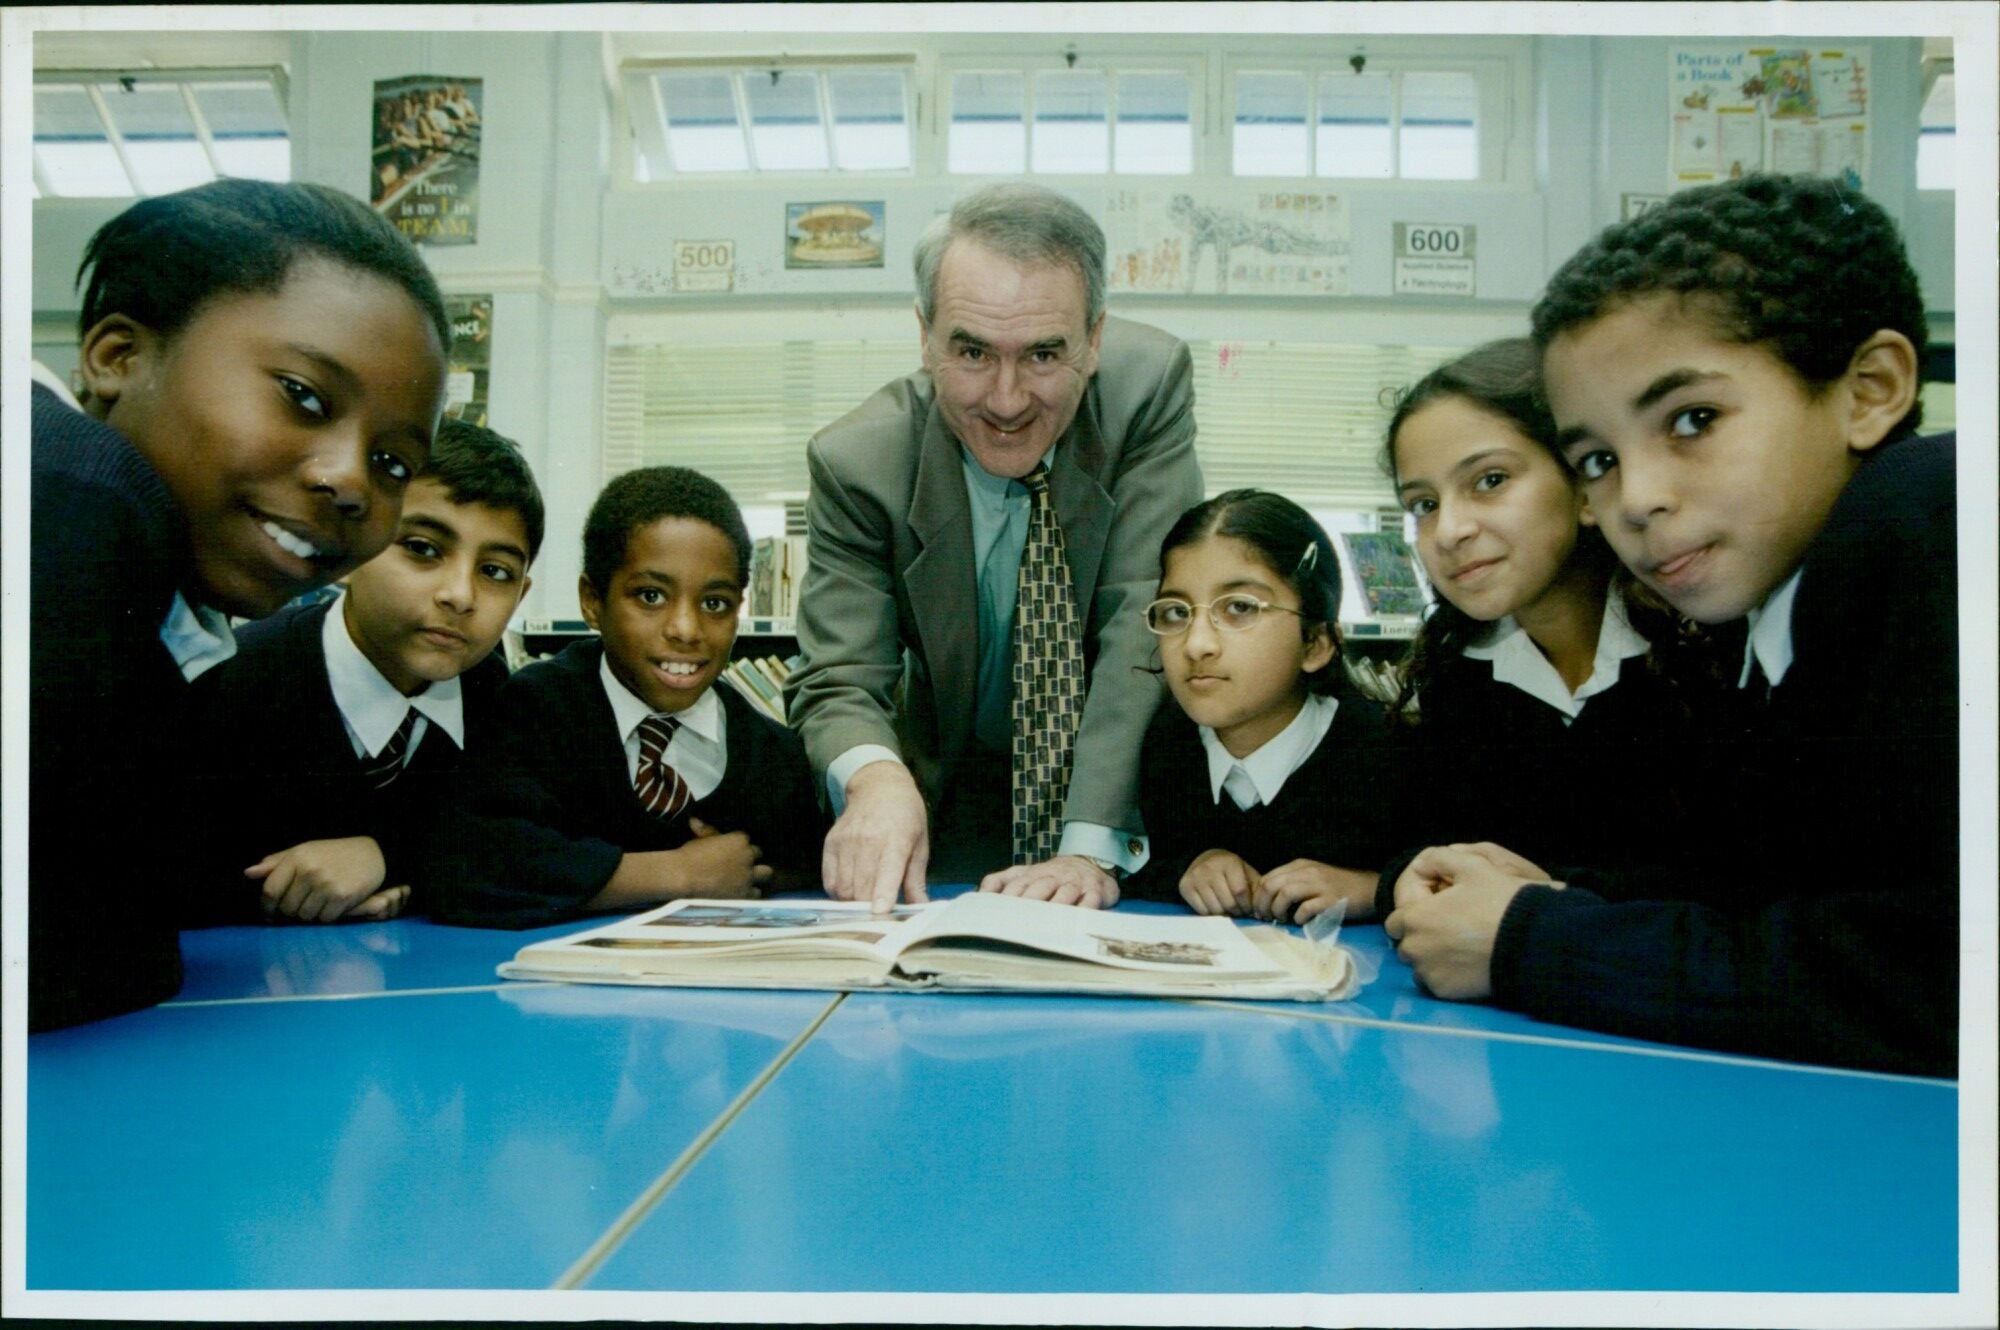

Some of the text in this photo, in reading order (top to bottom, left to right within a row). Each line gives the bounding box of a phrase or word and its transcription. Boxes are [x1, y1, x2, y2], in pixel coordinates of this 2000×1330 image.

[1677, 53, 1721, 66] Parts
[1725, 52, 1744, 66] of
[1691, 68, 1733, 81] Book
[416, 181, 458, 196] There
[402, 195, 470, 216] is no I in
[1411, 229, 1459, 252] 600
[681, 245, 729, 268] 500
